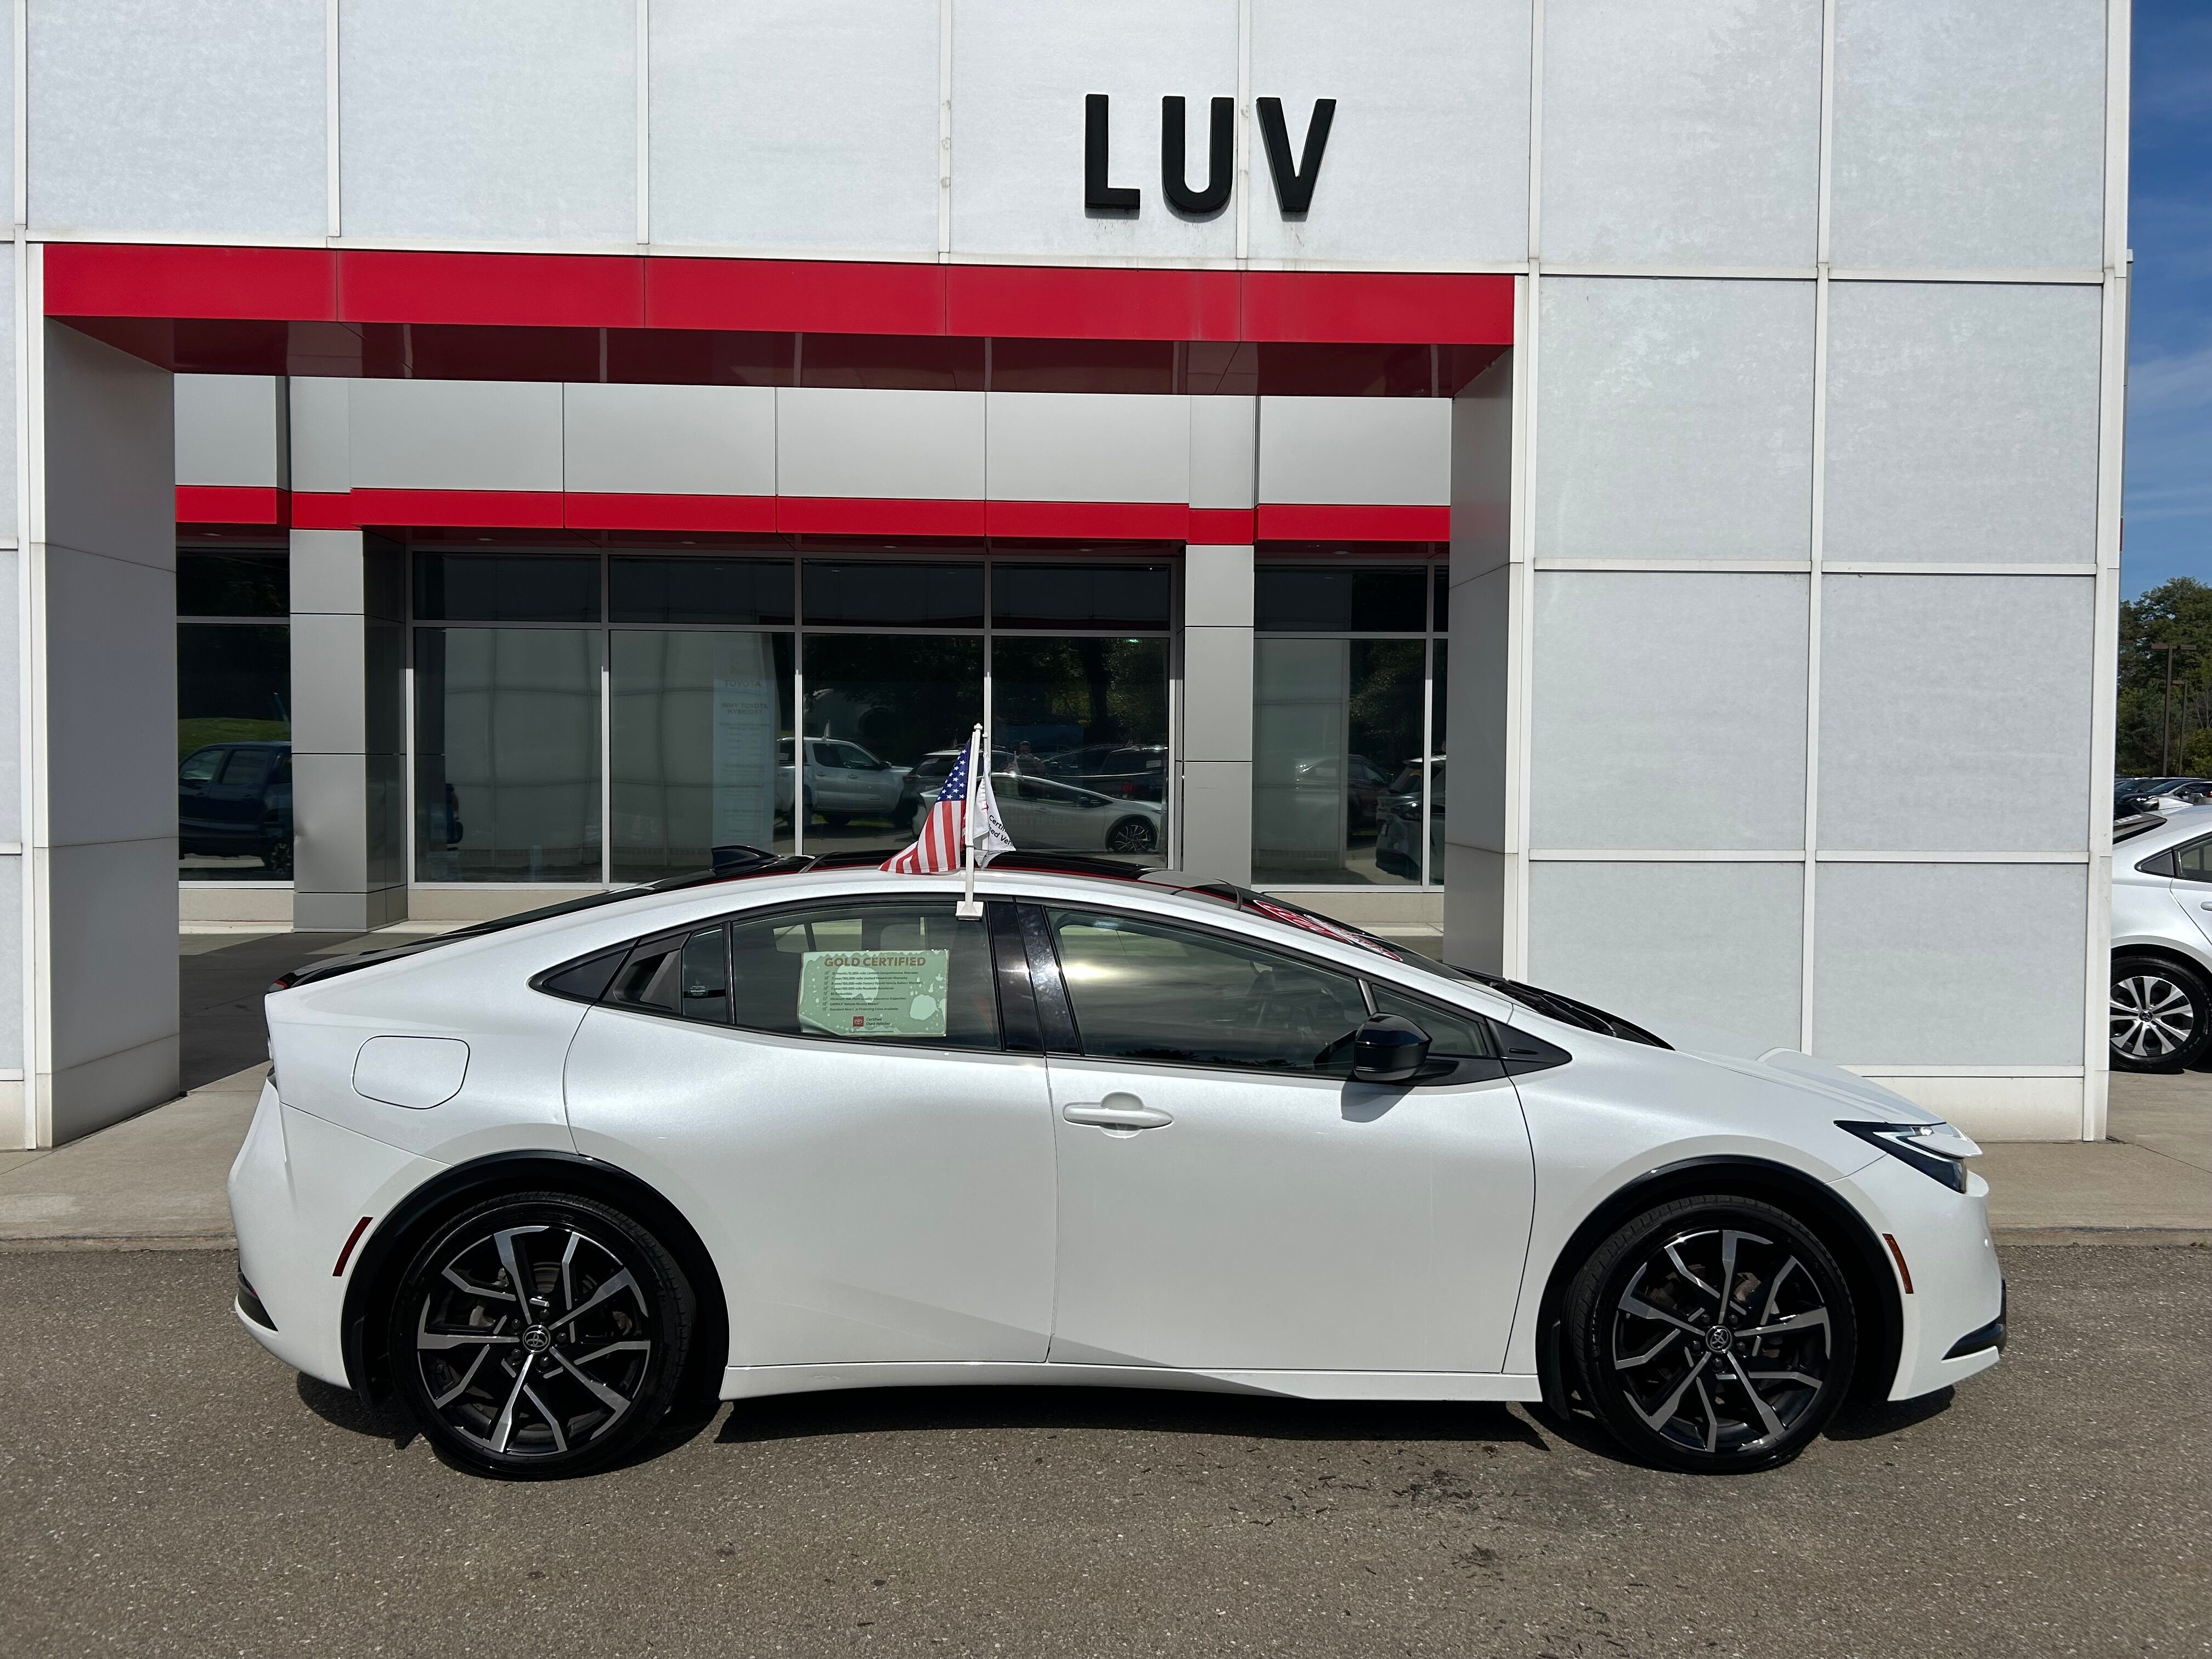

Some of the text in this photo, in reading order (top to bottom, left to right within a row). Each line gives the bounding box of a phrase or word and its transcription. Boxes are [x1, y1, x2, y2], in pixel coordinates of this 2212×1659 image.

[1085, 94, 1336, 222] LUV
[824, 957, 926, 967] GOLD CERTIFIED
